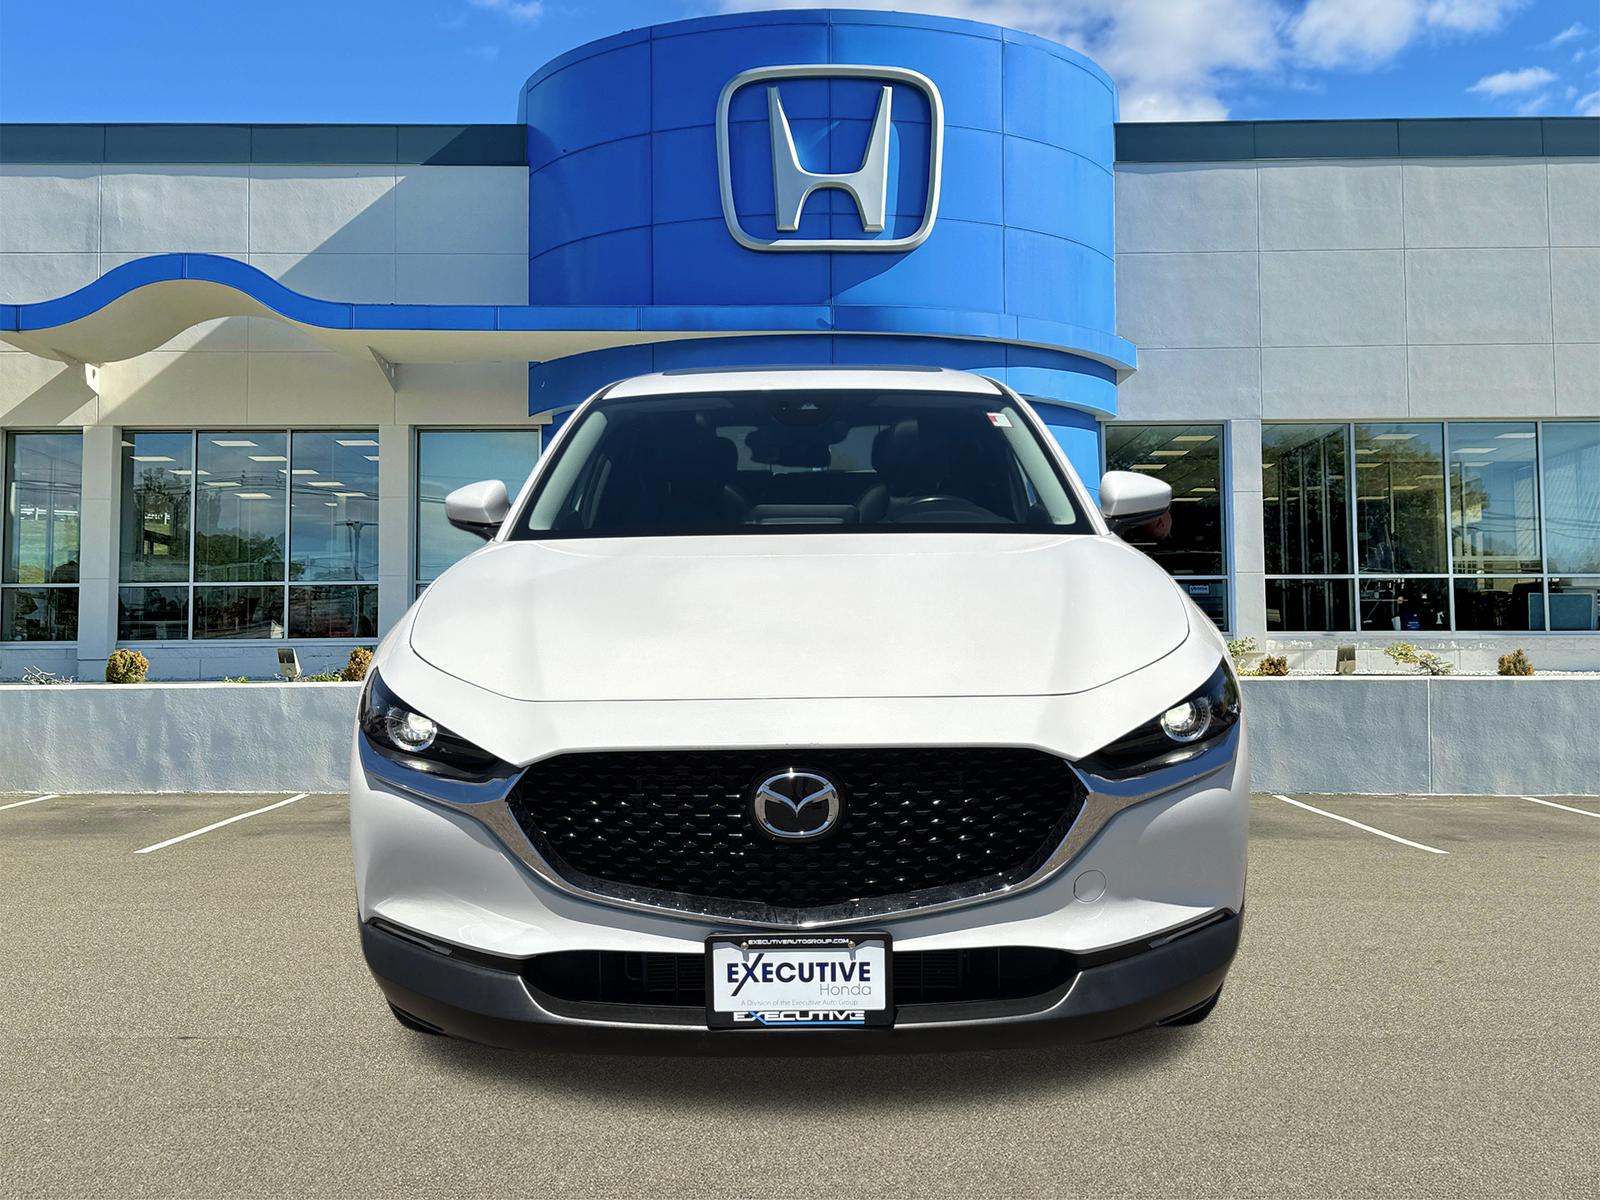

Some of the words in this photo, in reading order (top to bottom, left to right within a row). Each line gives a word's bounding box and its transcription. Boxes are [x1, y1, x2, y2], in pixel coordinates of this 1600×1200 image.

[727, 953, 870, 996] EXECUTIVE
[819, 984, 872, 996] Honda
[838, 999, 858, 1007] Group
[733, 1010, 865, 1023] EXECUTIVE
